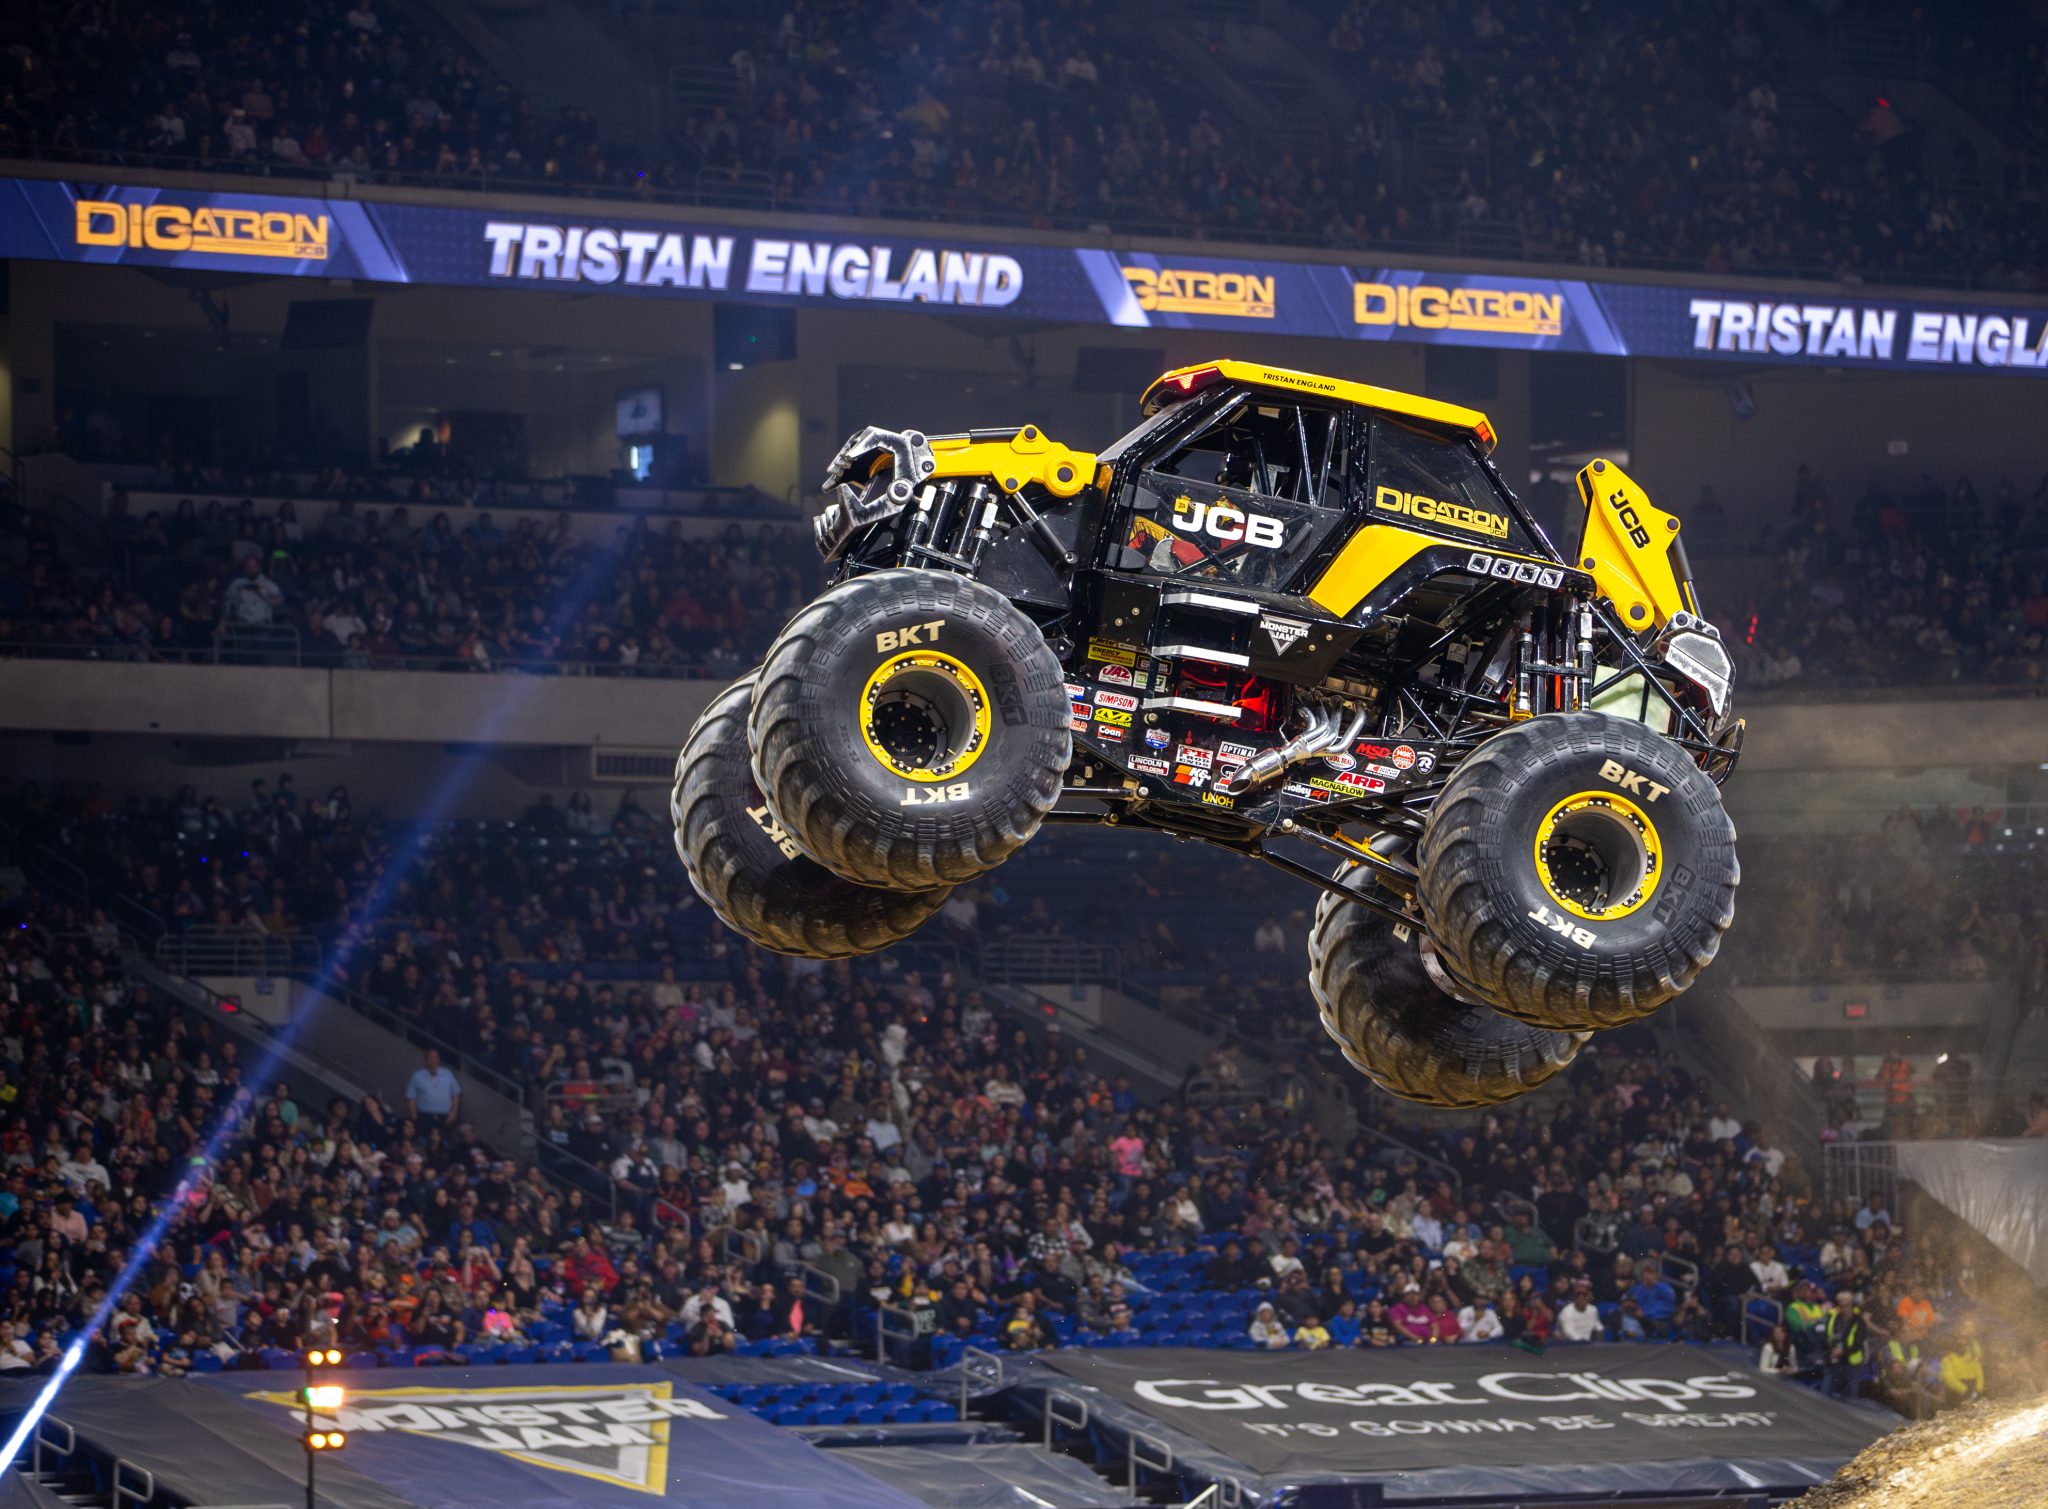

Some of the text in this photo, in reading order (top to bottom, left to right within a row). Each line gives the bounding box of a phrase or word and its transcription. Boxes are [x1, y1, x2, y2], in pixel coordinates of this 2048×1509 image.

[76, 200, 328, 250] DIGATRON
[484, 221, 1023, 307] TRISTAN ENGLAND
[1354, 282, 1561, 329] DIGATRON
[1689, 299, 1897, 359] TRISTAN
[1263, 373, 1336, 391] TRISTAN ENGLAND
[1376, 486, 1509, 532] DIGATRON
[1609, 488, 1650, 549] JCB
[1172, 502, 1285, 549] JCB
[876, 620, 946, 653] BKT
[1260, 620, 1309, 638] MONSTER
[1272, 631, 1294, 642] JAM
[1102, 664, 1130, 679] JAZ
[1099, 693, 1135, 708] SIMPSON
[1099, 725, 1121, 738] Coan
[1130, 755, 1164, 767] LINCOLN
[1222, 744, 1254, 758] OPTIMA
[1355, 743, 1391, 758] MSD
[900, 782, 970, 806] BKT
[1311, 777, 1363, 796] MAGNAFLOW
[1338, 772, 1384, 789] ARP
[1598, 758, 1671, 803] BKT
[1202, 791, 1235, 808] UNOH
[745, 805, 803, 861] BKT
[1655, 864, 1694, 926] BKT
[1528, 905, 1598, 950] BKT
[1134, 1371, 1757, 1412] Great Clips
[288, 1396, 729, 1432] MONSTER
[1241, 1420, 1340, 1438] IT'S
[1350, 1417, 1537, 1437] GONNA
[1537, 1414, 1616, 1430] BE
[478, 1423, 658, 1450] JAM
